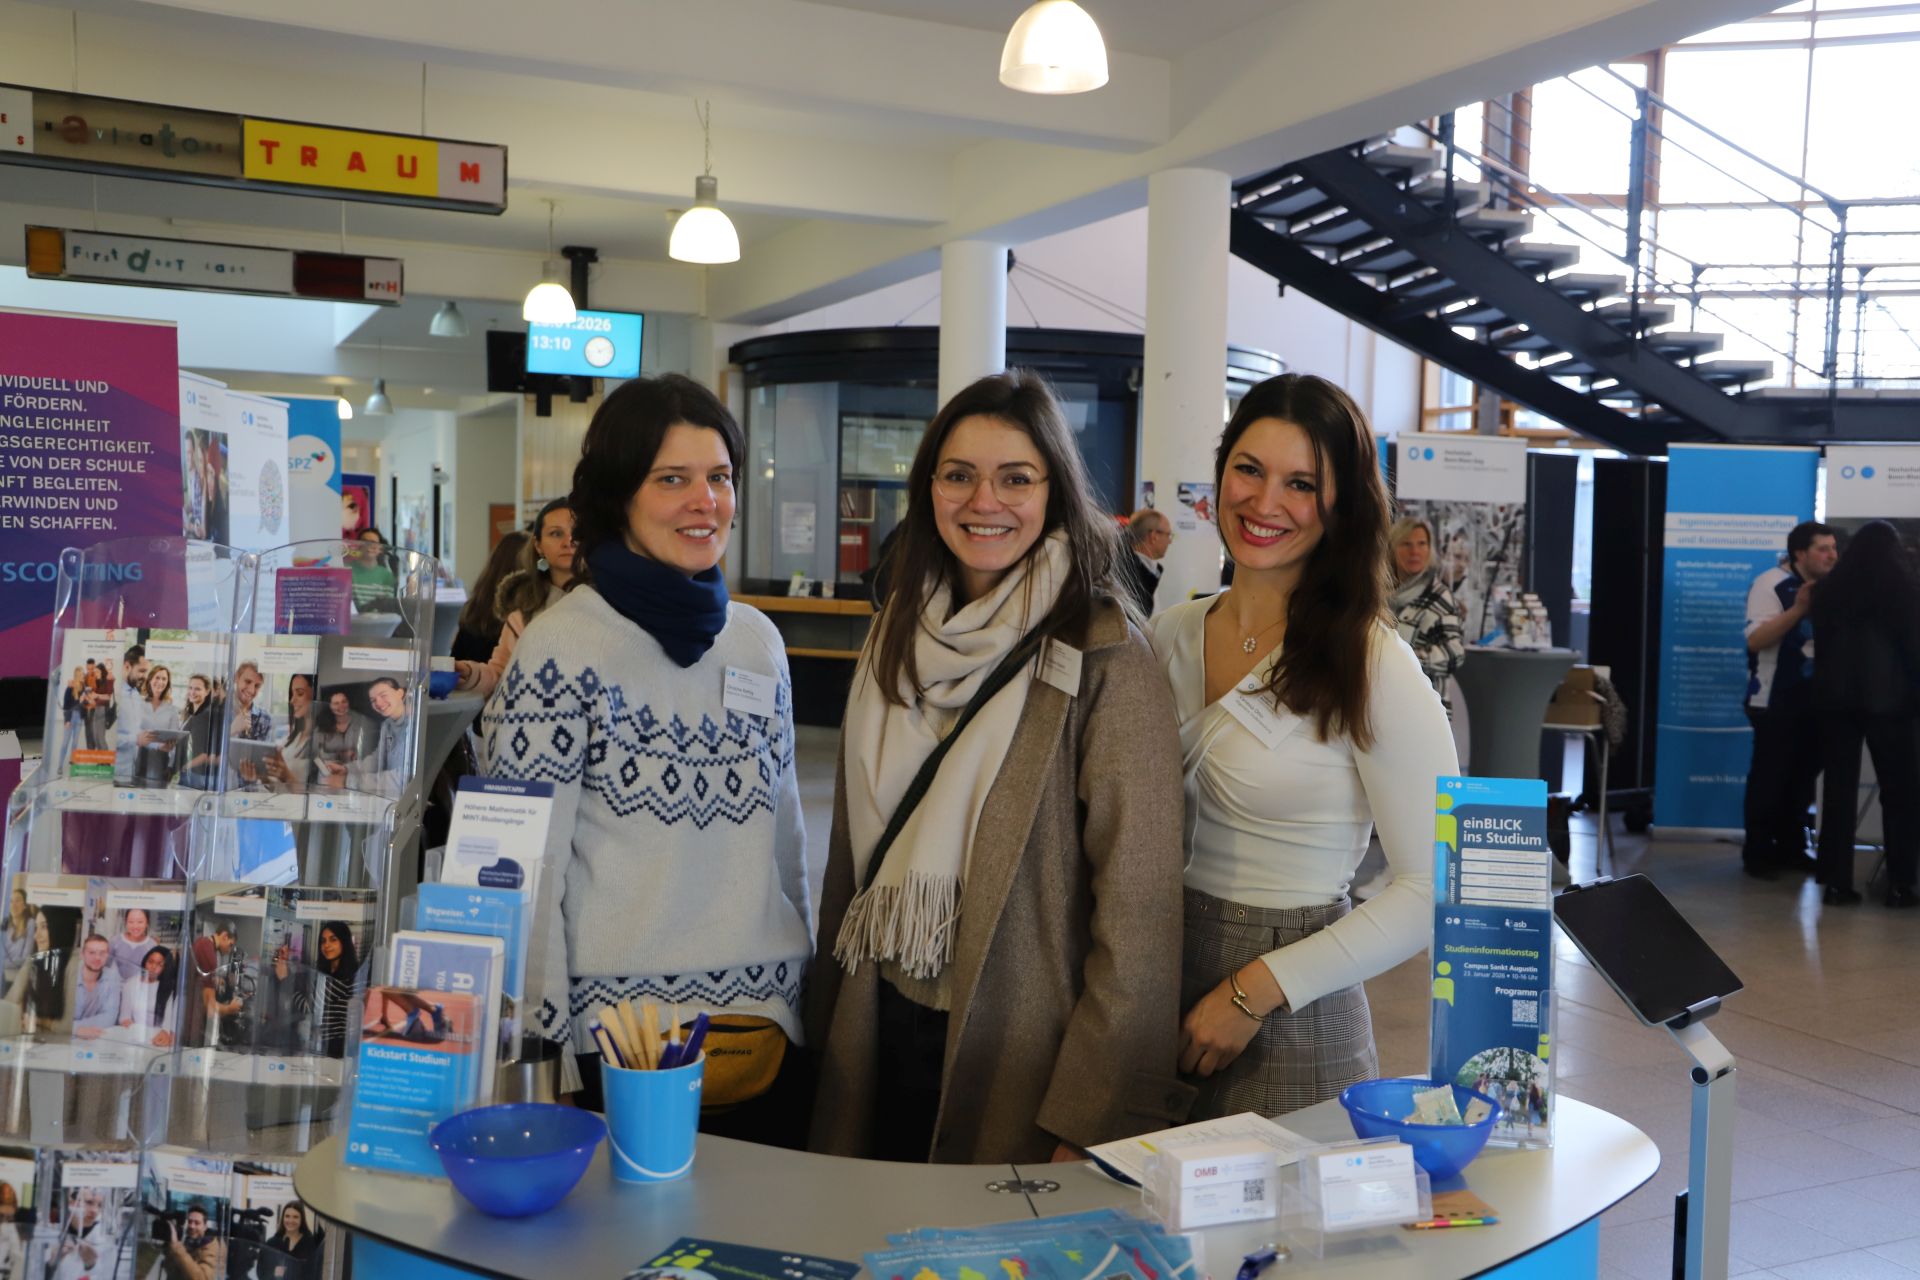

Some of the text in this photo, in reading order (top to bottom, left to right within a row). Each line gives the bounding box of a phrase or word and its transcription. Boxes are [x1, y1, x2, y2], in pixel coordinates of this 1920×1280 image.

[531, 335, 571, 351] 13:10
[75, 380, 109, 394] UND
[4, 392, 87, 412] FÖRDERN.
[0, 415, 111, 433] NGLEICHHEIT
[0, 435, 154, 454] GSGERECHTIGKEIT.
[9, 455, 42, 469] VON
[48, 457, 81, 471] DER
[86, 459, 146, 473] SCHULE
[33, 477, 122, 492] BEGLEITEN.
[0, 495, 118, 511] RWINDEN UND
[0, 516, 117, 530] EN SCHAFFEN.
[1677, 535, 1774, 546] und Kommunikation
[0, 562, 143, 582] SCOUTING
[1463, 816, 1523, 831] einBLICK
[1463, 830, 1543, 846] ins Studium
[1513, 920, 1528, 929] asb
[1443, 944, 1540, 959] Studieninformationstag
[1463, 962, 1538, 973] Campus Sankt Augustin
[1494, 986, 1538, 997] Programm
[366, 1046, 451, 1067] Kickstart Studium!
[1193, 1166, 1218, 1178] OMB
